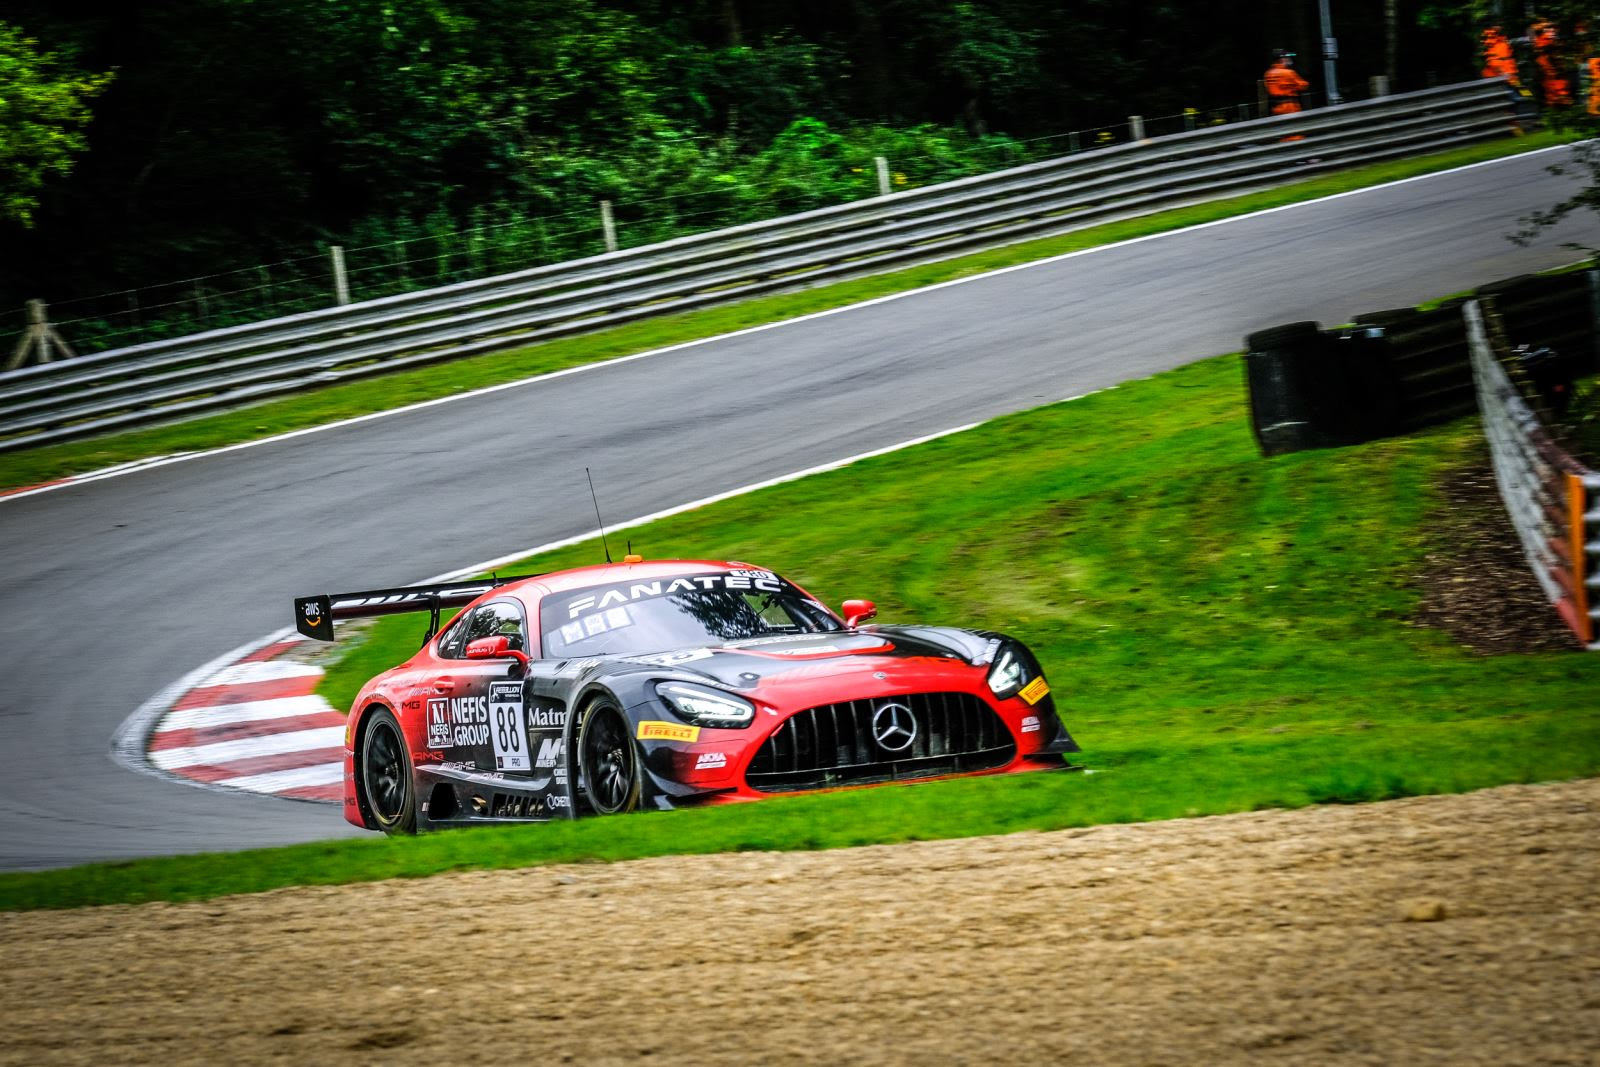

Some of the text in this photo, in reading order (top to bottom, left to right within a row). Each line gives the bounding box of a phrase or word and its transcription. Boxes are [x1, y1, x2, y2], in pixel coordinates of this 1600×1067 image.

[568, 576, 782, 619] FANATEC
[305, 603, 320, 616] aws
[451, 696, 488, 724] NEFIS
[455, 724, 490, 746] GROUP
[496, 706, 520, 752] 88
[643, 725, 693, 739] PIRELLI
[413, 751, 445, 760] AMG
